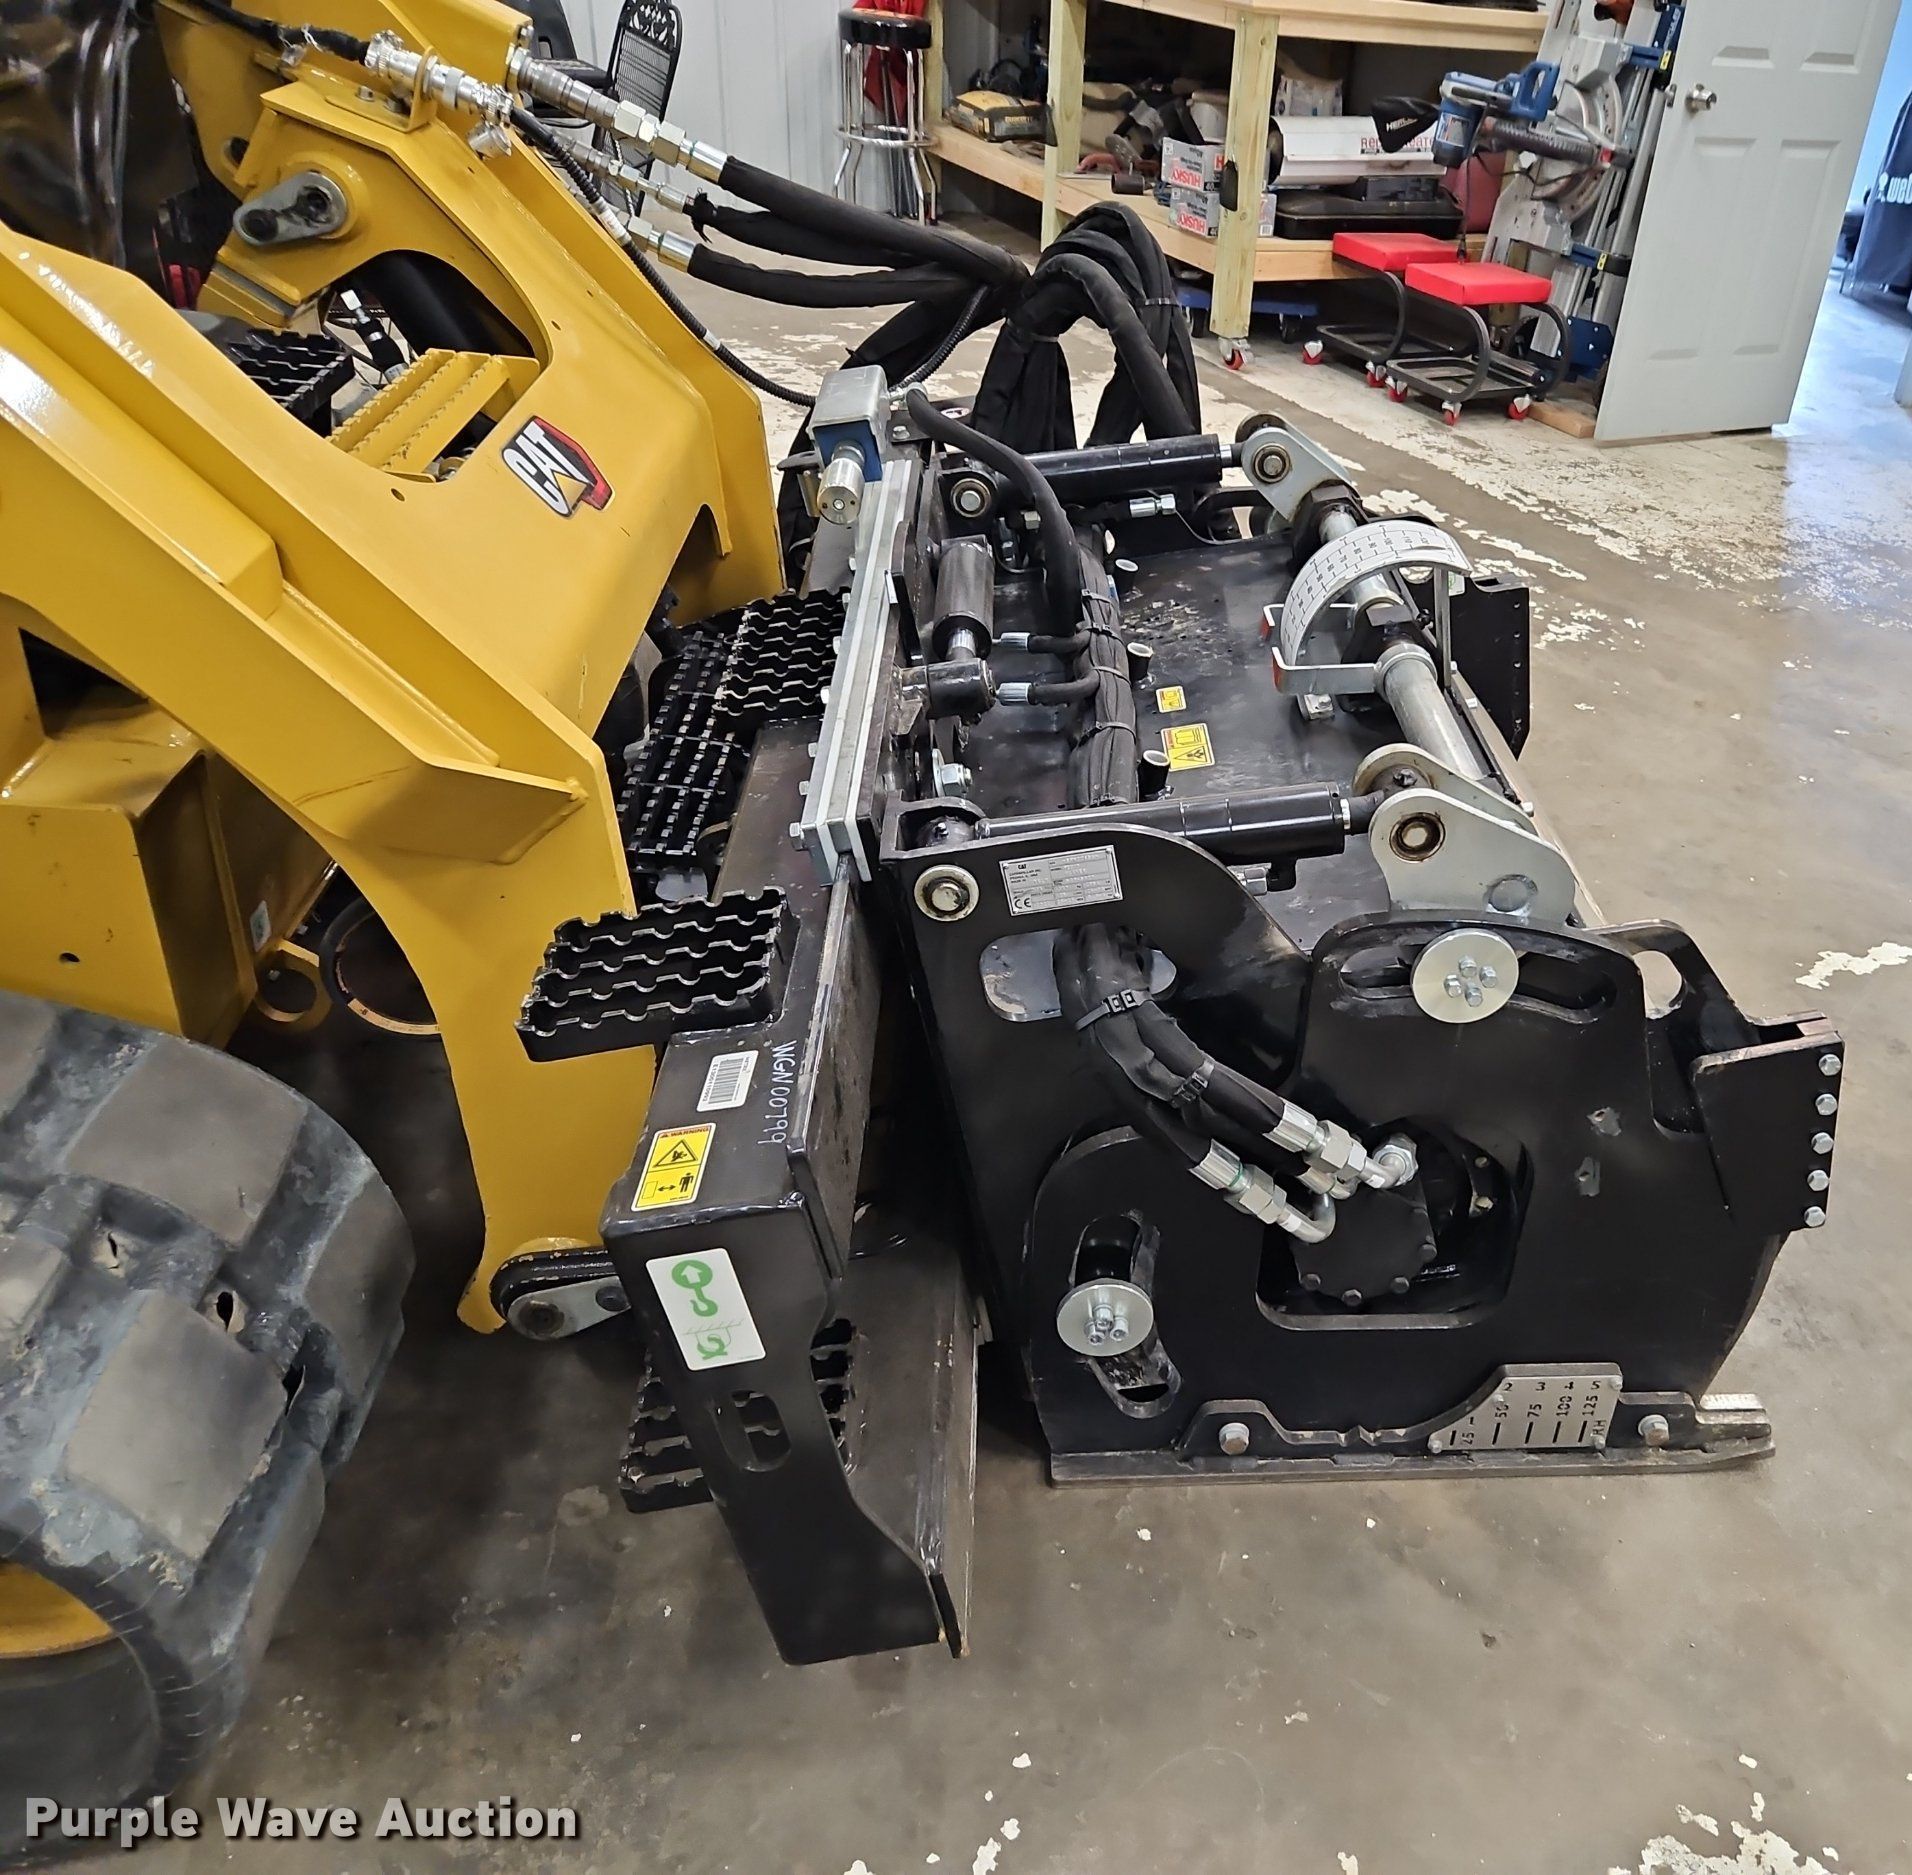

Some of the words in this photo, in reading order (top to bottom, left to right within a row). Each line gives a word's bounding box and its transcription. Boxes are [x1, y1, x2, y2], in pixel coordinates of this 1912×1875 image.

[1172, 169, 1201, 187] HUSKY
[1178, 213, 1205, 233] HUSKY
[502, 420, 590, 515] CAT
[1014, 898, 1031, 909] CE
[1503, 1382, 1513, 1391] 2
[1535, 1381, 1546, 1391] 3
[1564, 1381, 1574, 1390] 4
[1590, 1380, 1601, 1389] 5
[1527, 1403, 1542, 1418] 75
[1556, 1395, 1572, 1417] 100
[1582, 1395, 1598, 1416] 125
